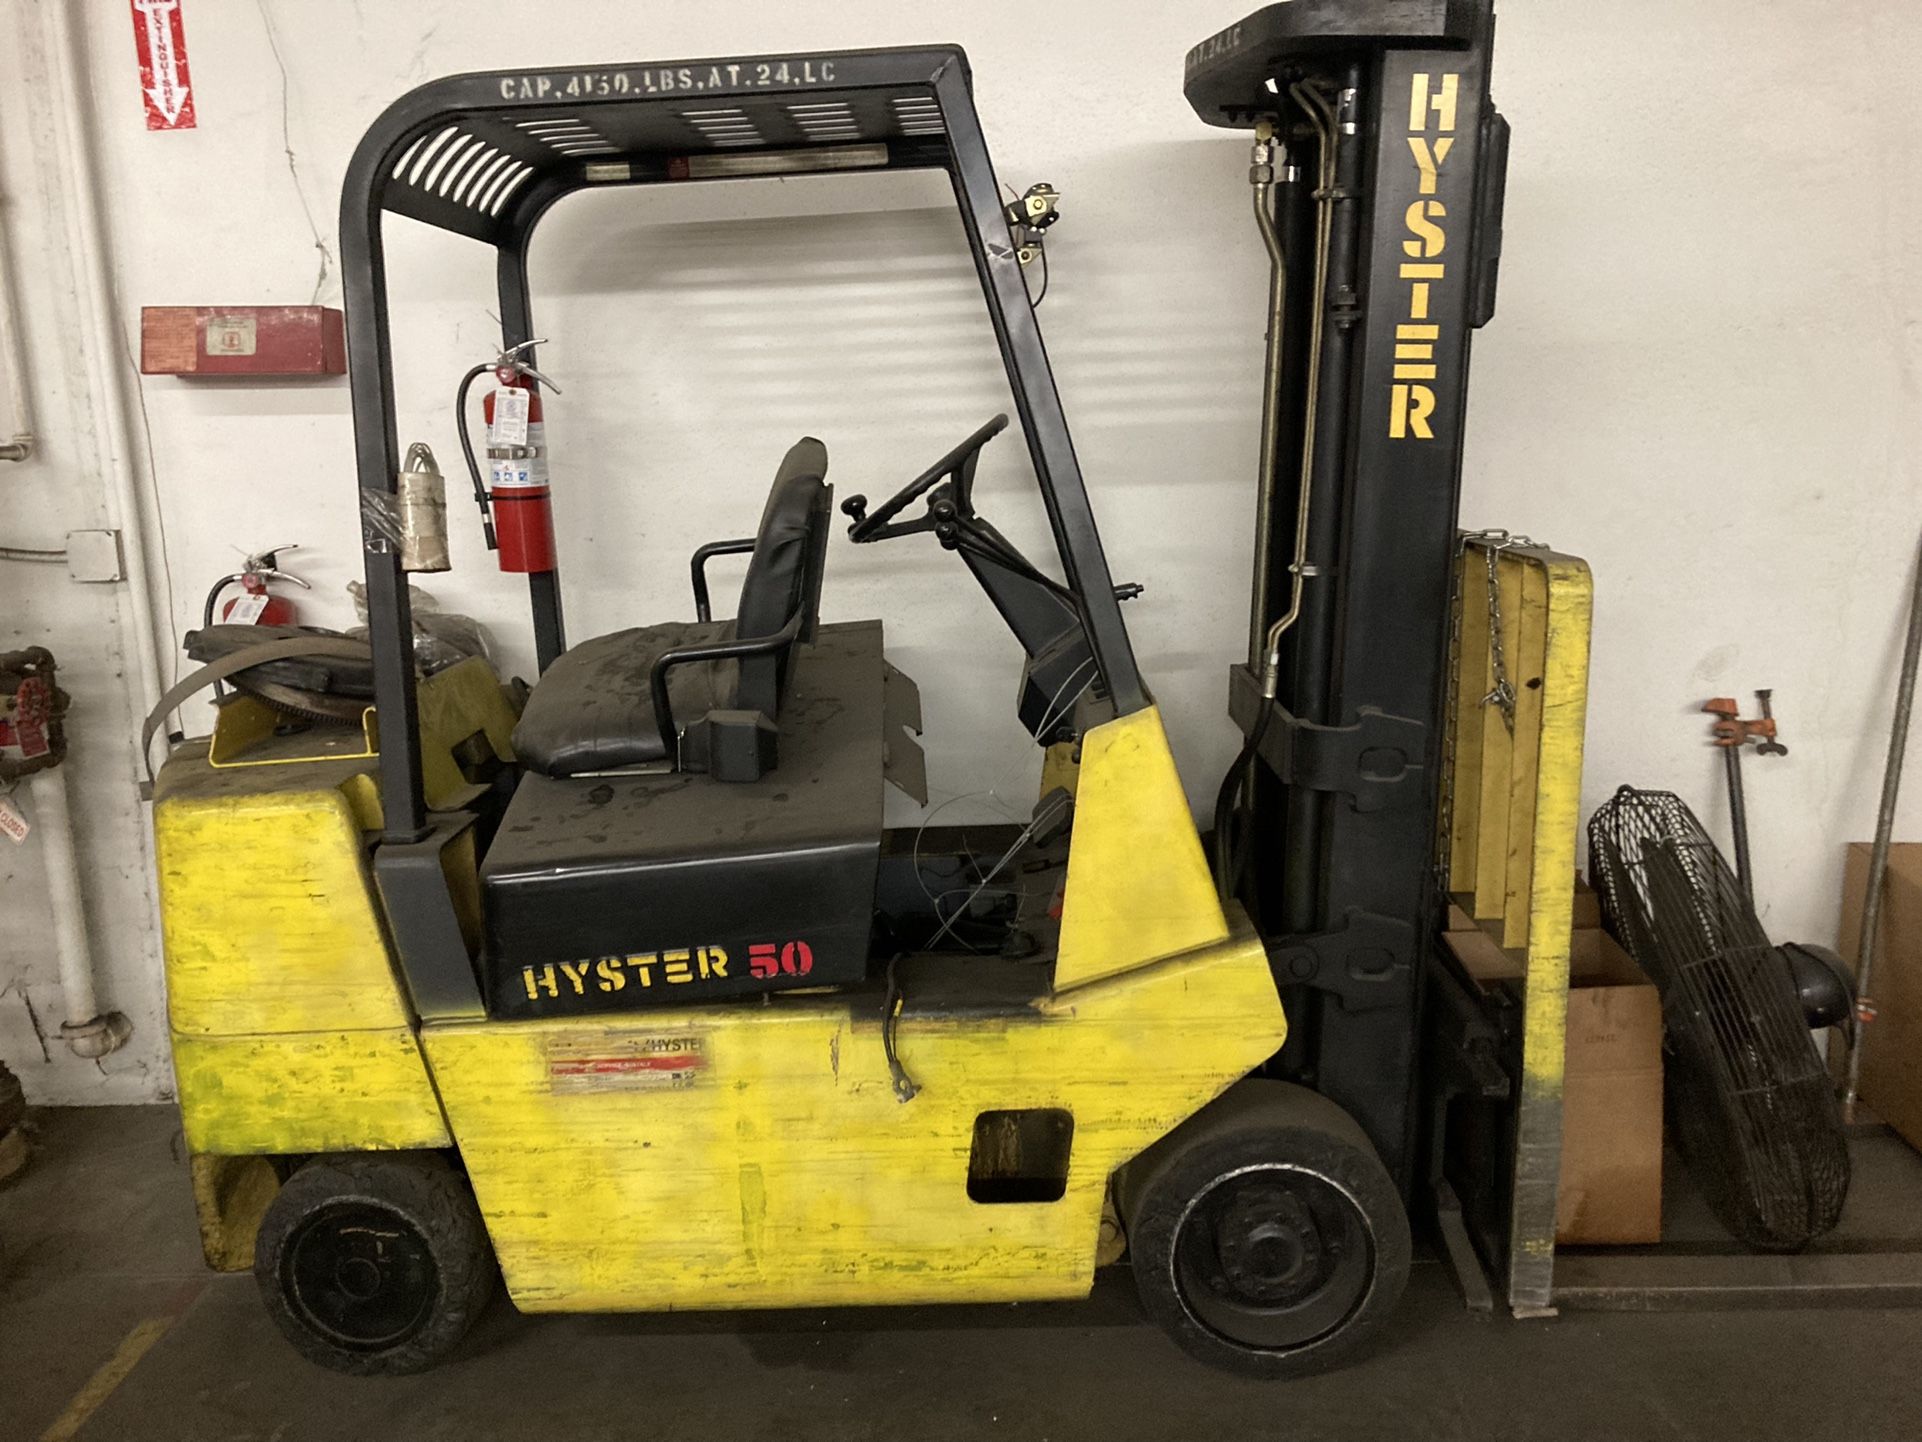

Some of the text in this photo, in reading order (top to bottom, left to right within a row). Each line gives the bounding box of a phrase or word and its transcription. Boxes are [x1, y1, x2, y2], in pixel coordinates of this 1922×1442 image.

[1388, 73, 1459, 438] HYSTER
[523, 941, 814, 1000] HYSTER 50
